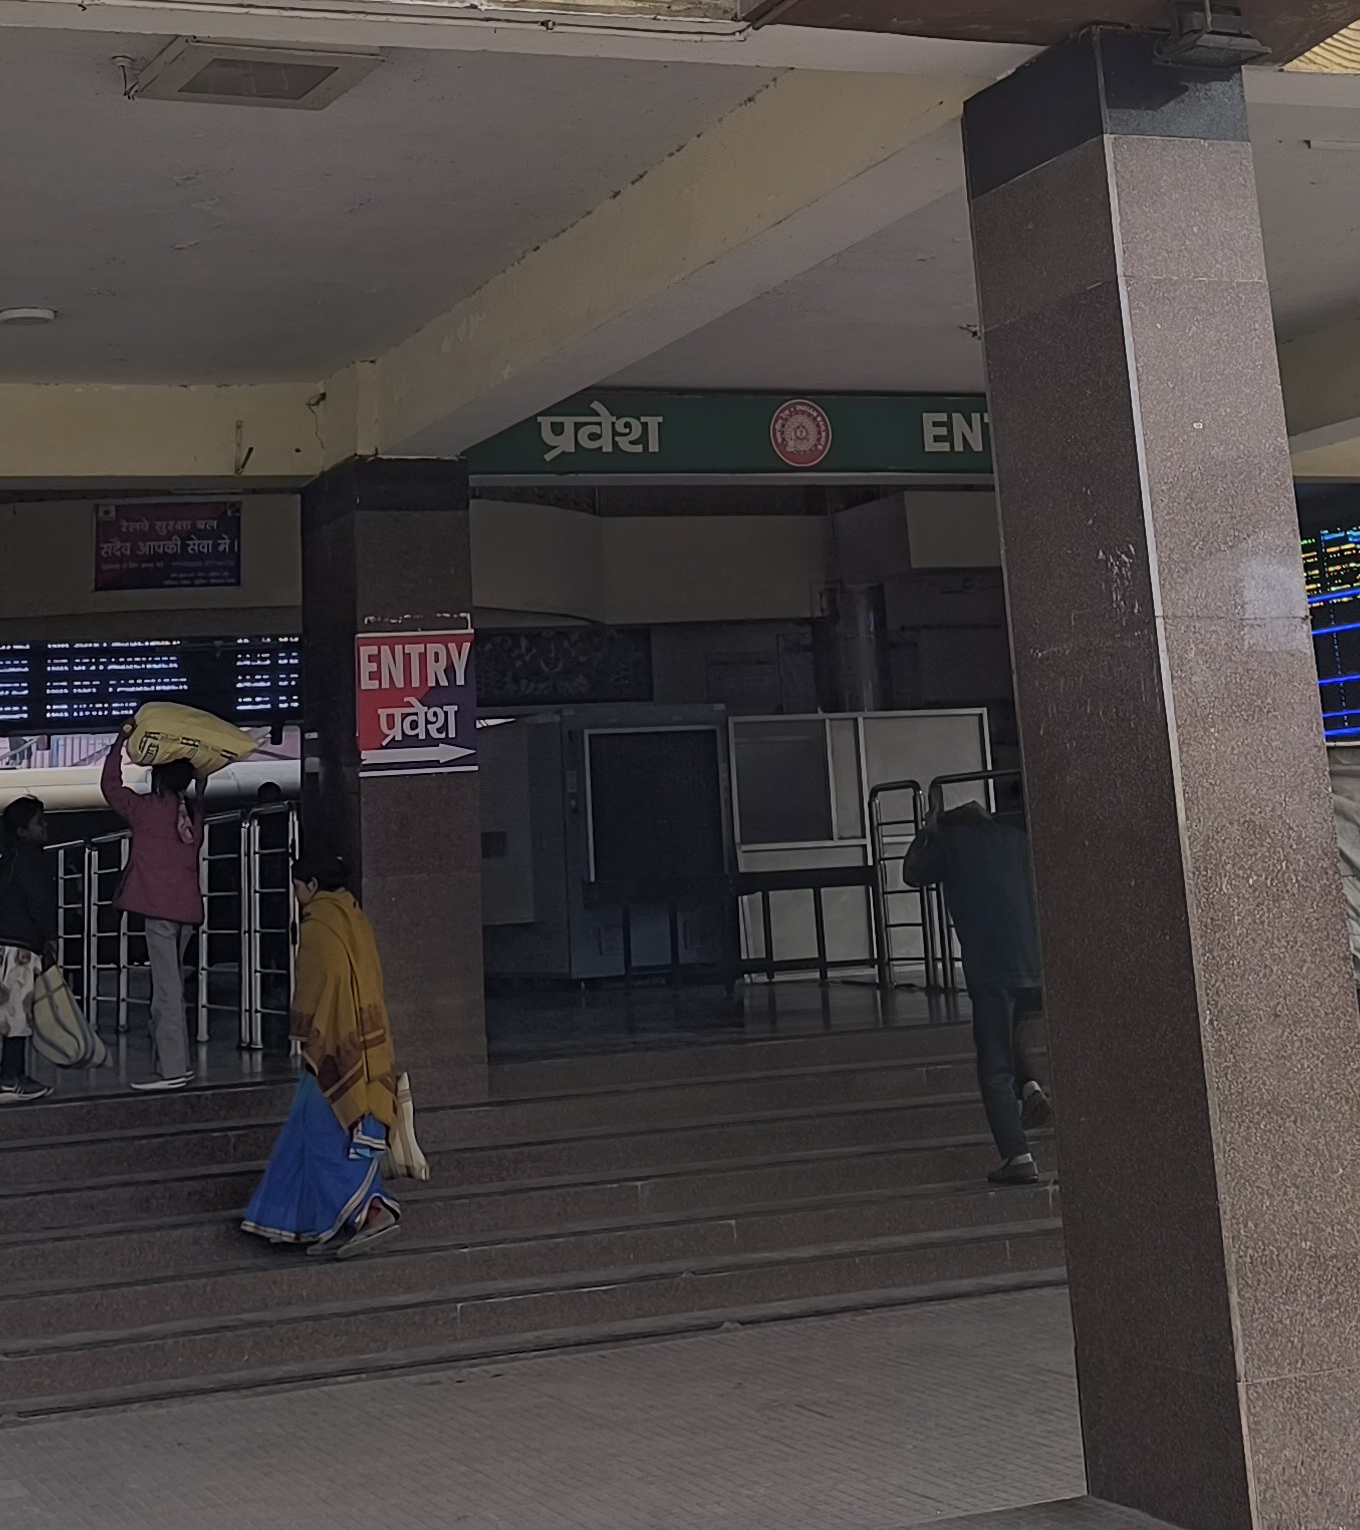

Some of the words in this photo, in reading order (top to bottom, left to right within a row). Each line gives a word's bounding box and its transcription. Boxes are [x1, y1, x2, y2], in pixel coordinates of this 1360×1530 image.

[537, 400, 663, 462] प्रवेश
[922, 412, 990, 452] EN
[99, 536, 132, 558] सदैव
[136, 535, 181, 556] आपकी
[186, 534, 213, 554] सेवा
[359, 642, 471, 690] ENTRY
[377, 696, 458, 747] प्रवेश
